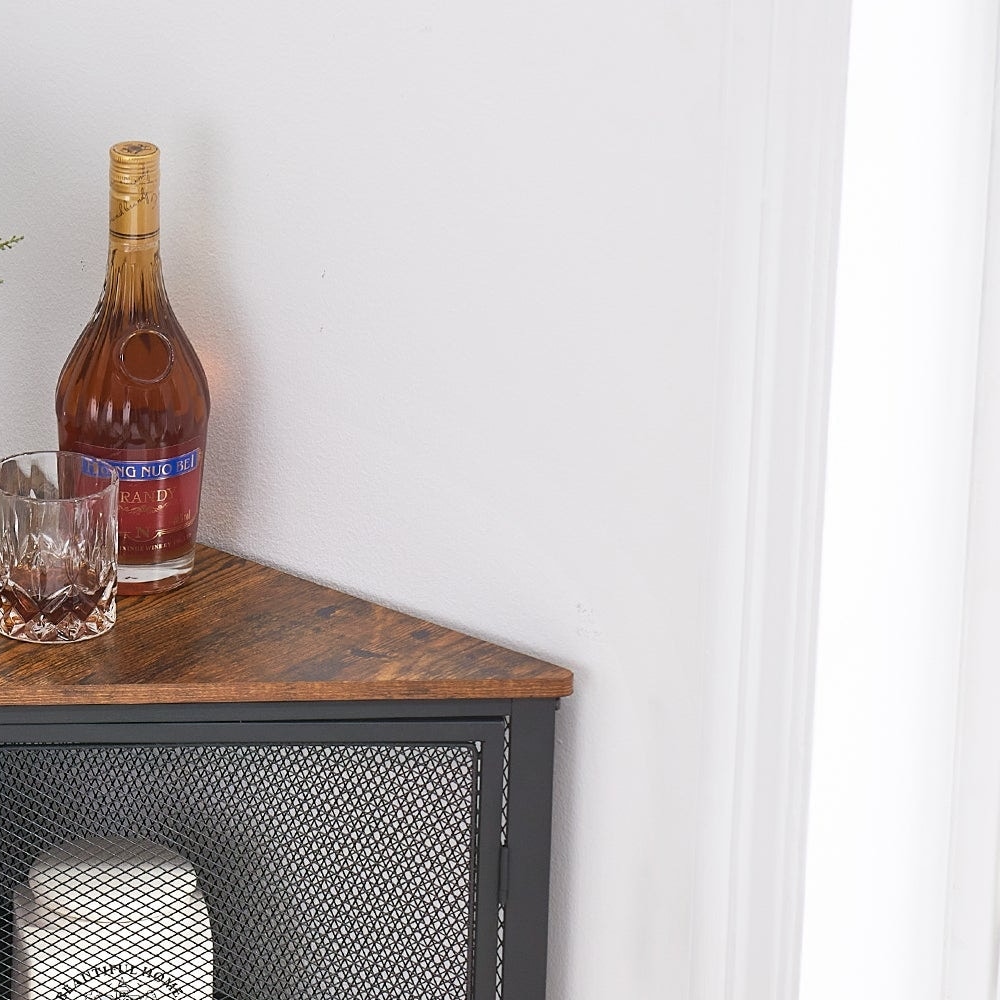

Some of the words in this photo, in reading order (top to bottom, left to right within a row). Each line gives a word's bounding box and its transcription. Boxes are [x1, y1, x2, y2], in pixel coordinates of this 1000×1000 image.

[141, 464, 172, 478] NUO
[176, 454, 195, 472] BEI
[119, 488, 176, 503] RANDY
[142, 966, 184, 998] HOME
